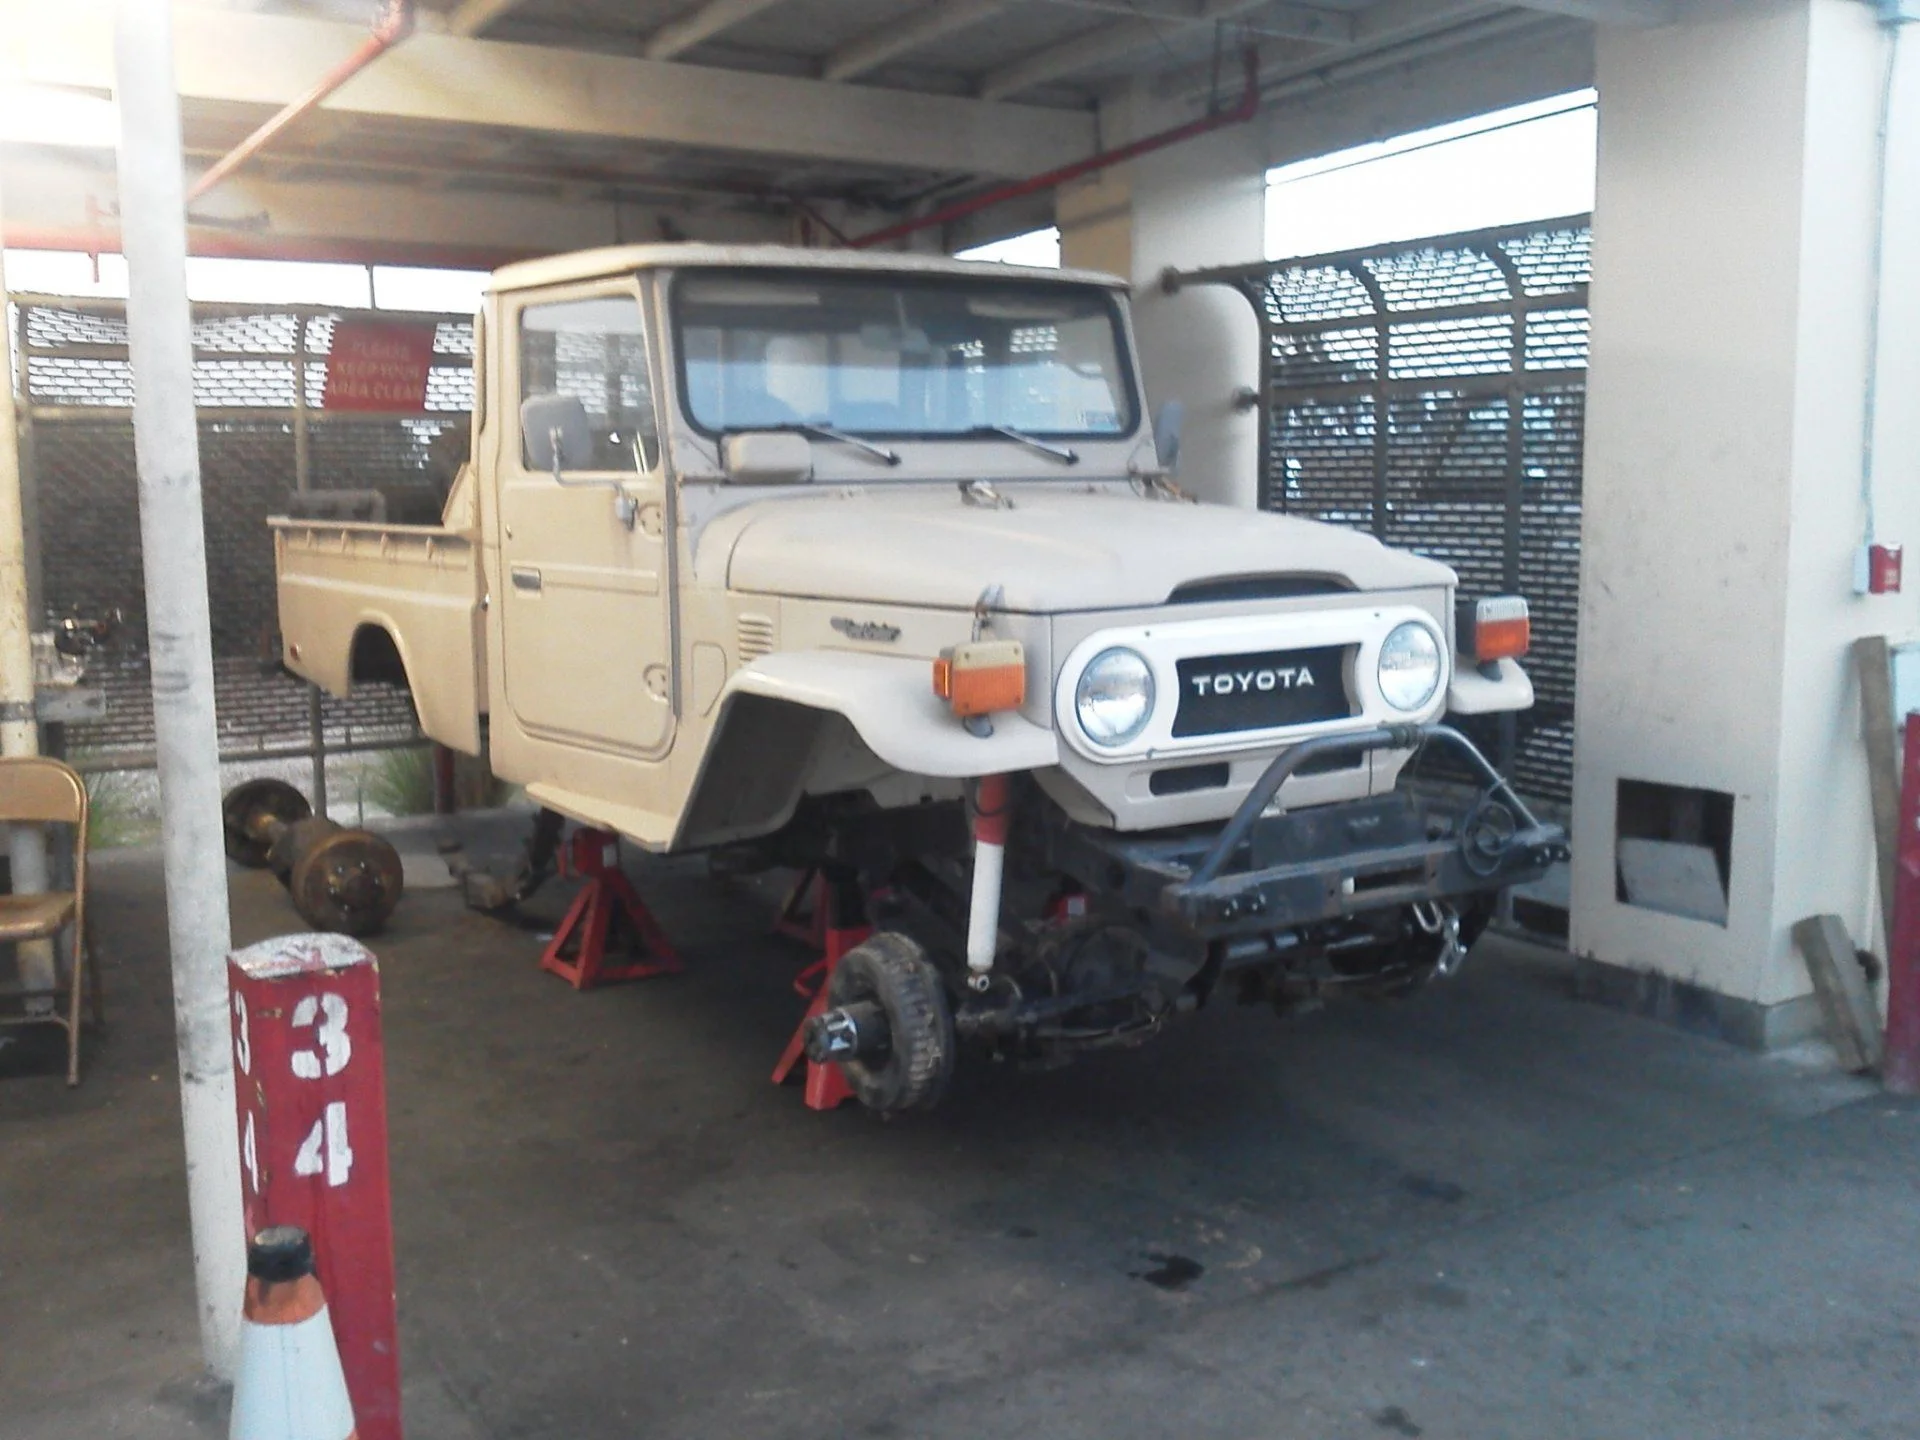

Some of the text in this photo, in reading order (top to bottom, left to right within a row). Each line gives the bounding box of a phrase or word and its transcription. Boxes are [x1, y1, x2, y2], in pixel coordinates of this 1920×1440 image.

[1192, 666, 1315, 697] TOYOTA
[291, 992, 352, 1079] 3
[294, 1101, 353, 1187] 4
